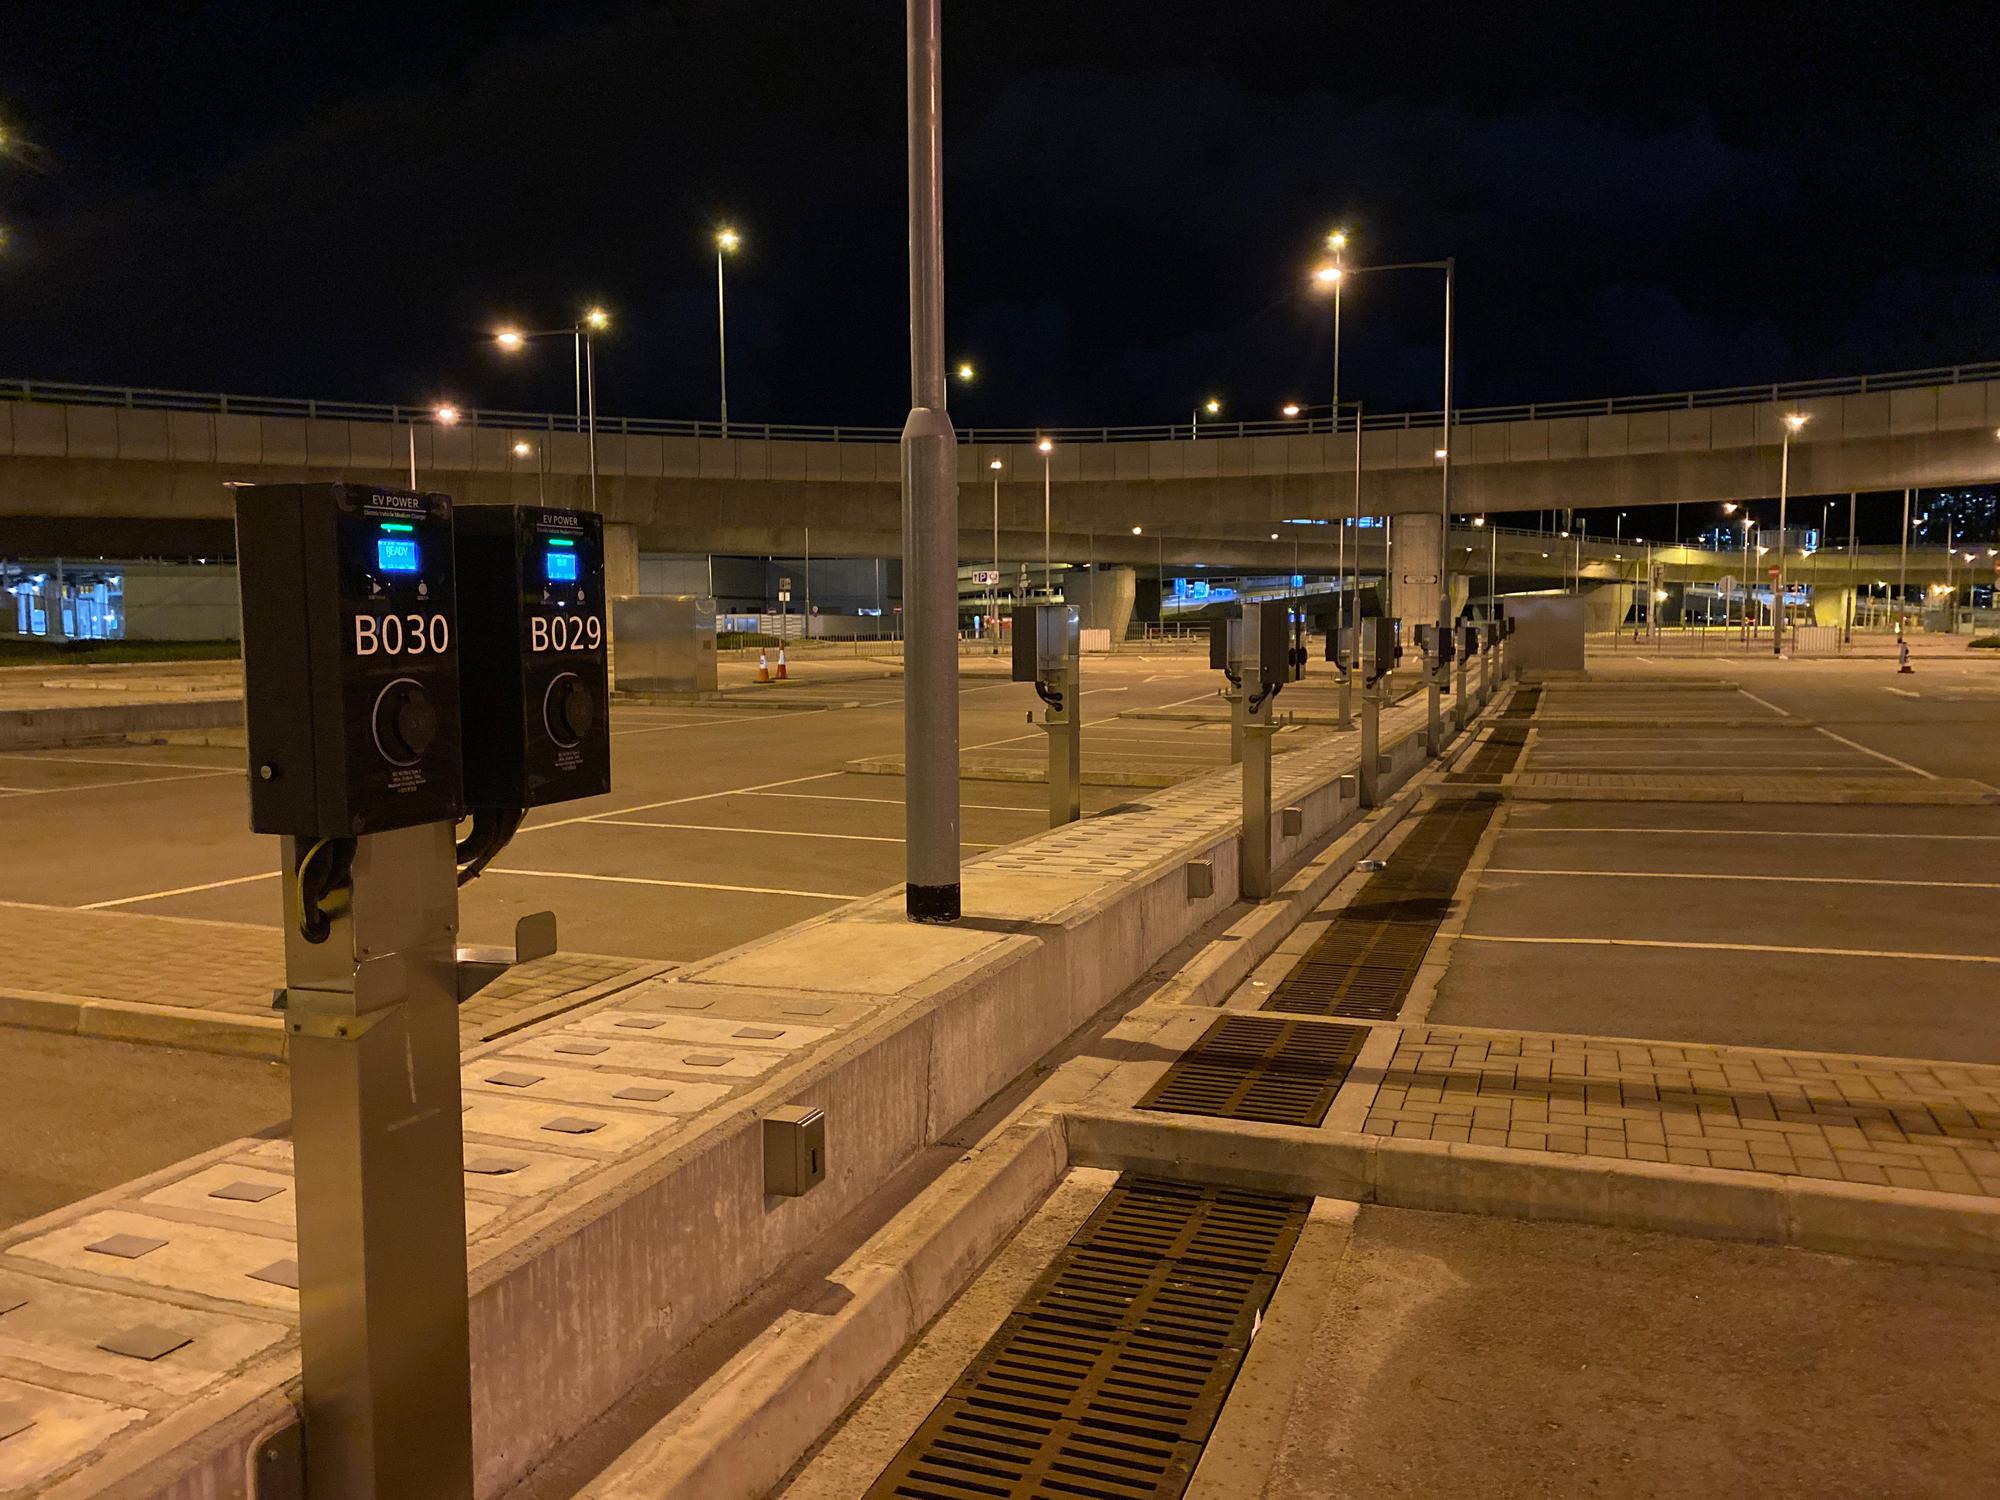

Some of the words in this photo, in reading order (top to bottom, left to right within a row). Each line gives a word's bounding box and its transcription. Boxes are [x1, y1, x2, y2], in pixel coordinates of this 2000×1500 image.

[372, 494, 384, 505] EV
[386, 495, 419, 508] POWER
[543, 514, 552, 524] EV
[553, 515, 578, 526] POWER
[386, 545, 408, 557] READY
[355, 614, 449, 656] B030
[531, 615, 601, 652] B029
